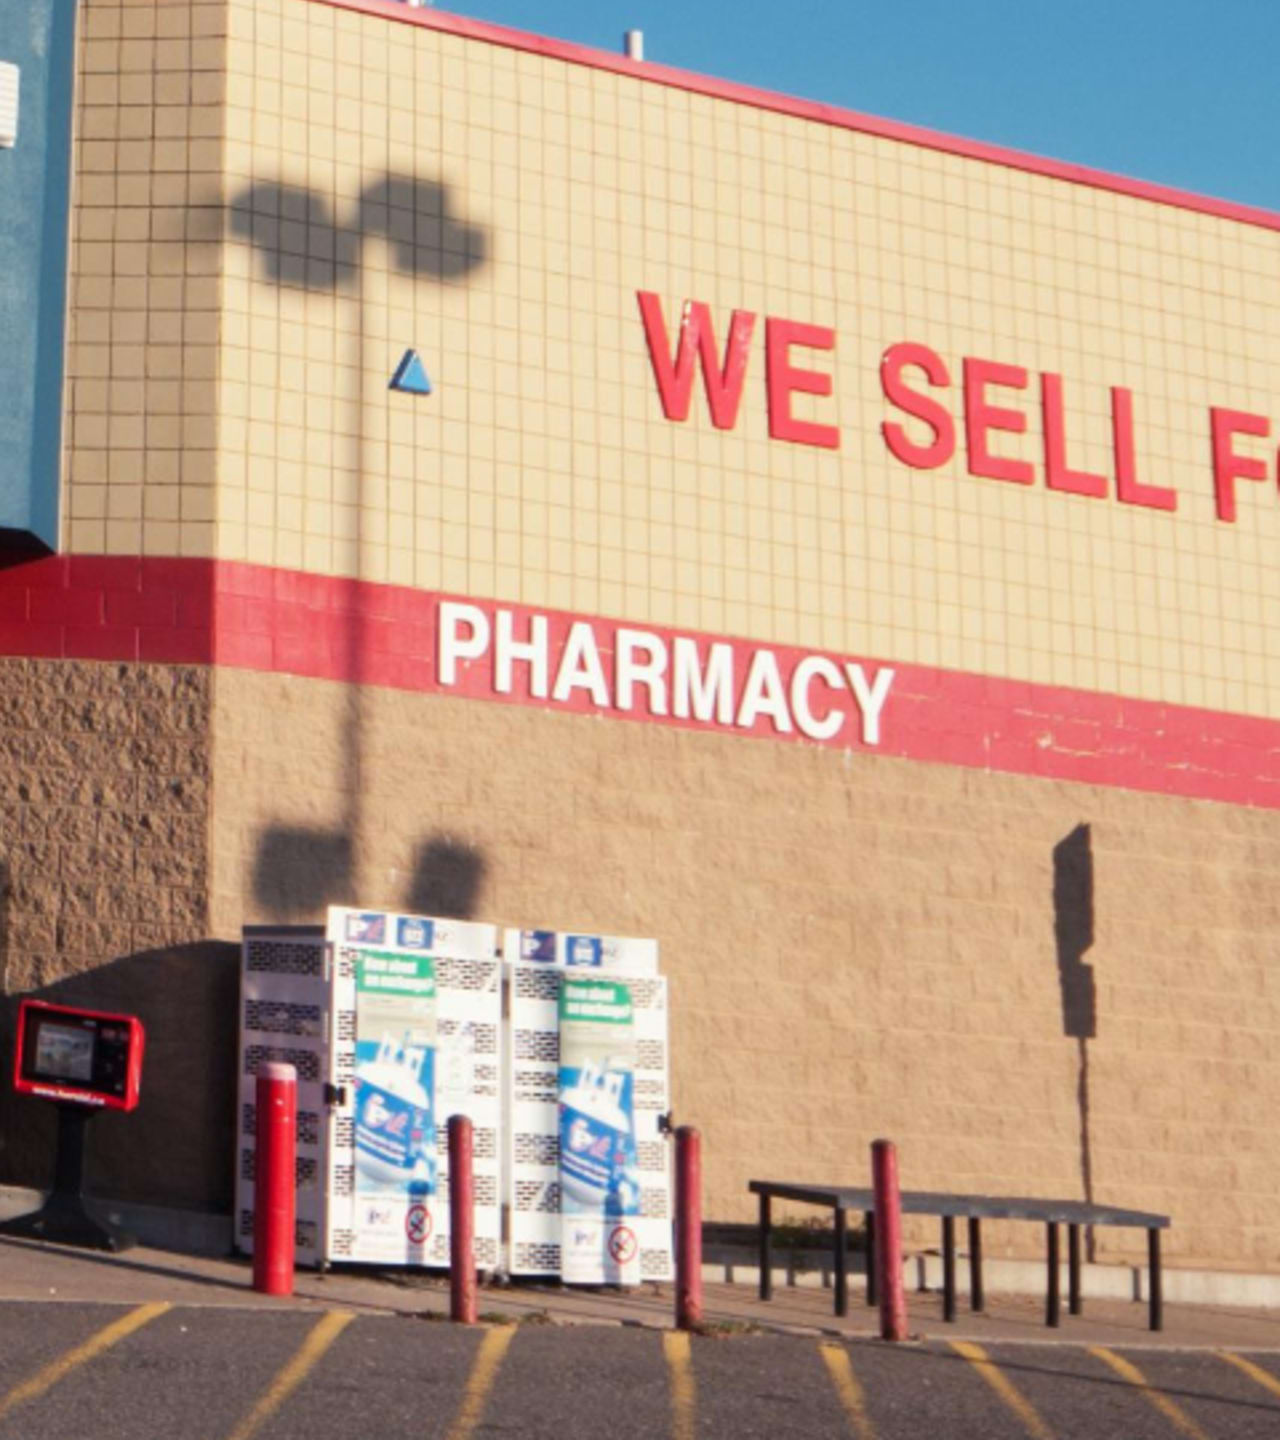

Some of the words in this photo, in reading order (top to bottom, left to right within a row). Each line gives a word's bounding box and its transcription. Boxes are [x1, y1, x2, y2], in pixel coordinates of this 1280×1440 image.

[636, 290, 840, 449] WE
[879, 342, 1177, 512] SELL
[1208, 405, 1280, 523] F
[437, 601, 895, 745] PHARMACY
